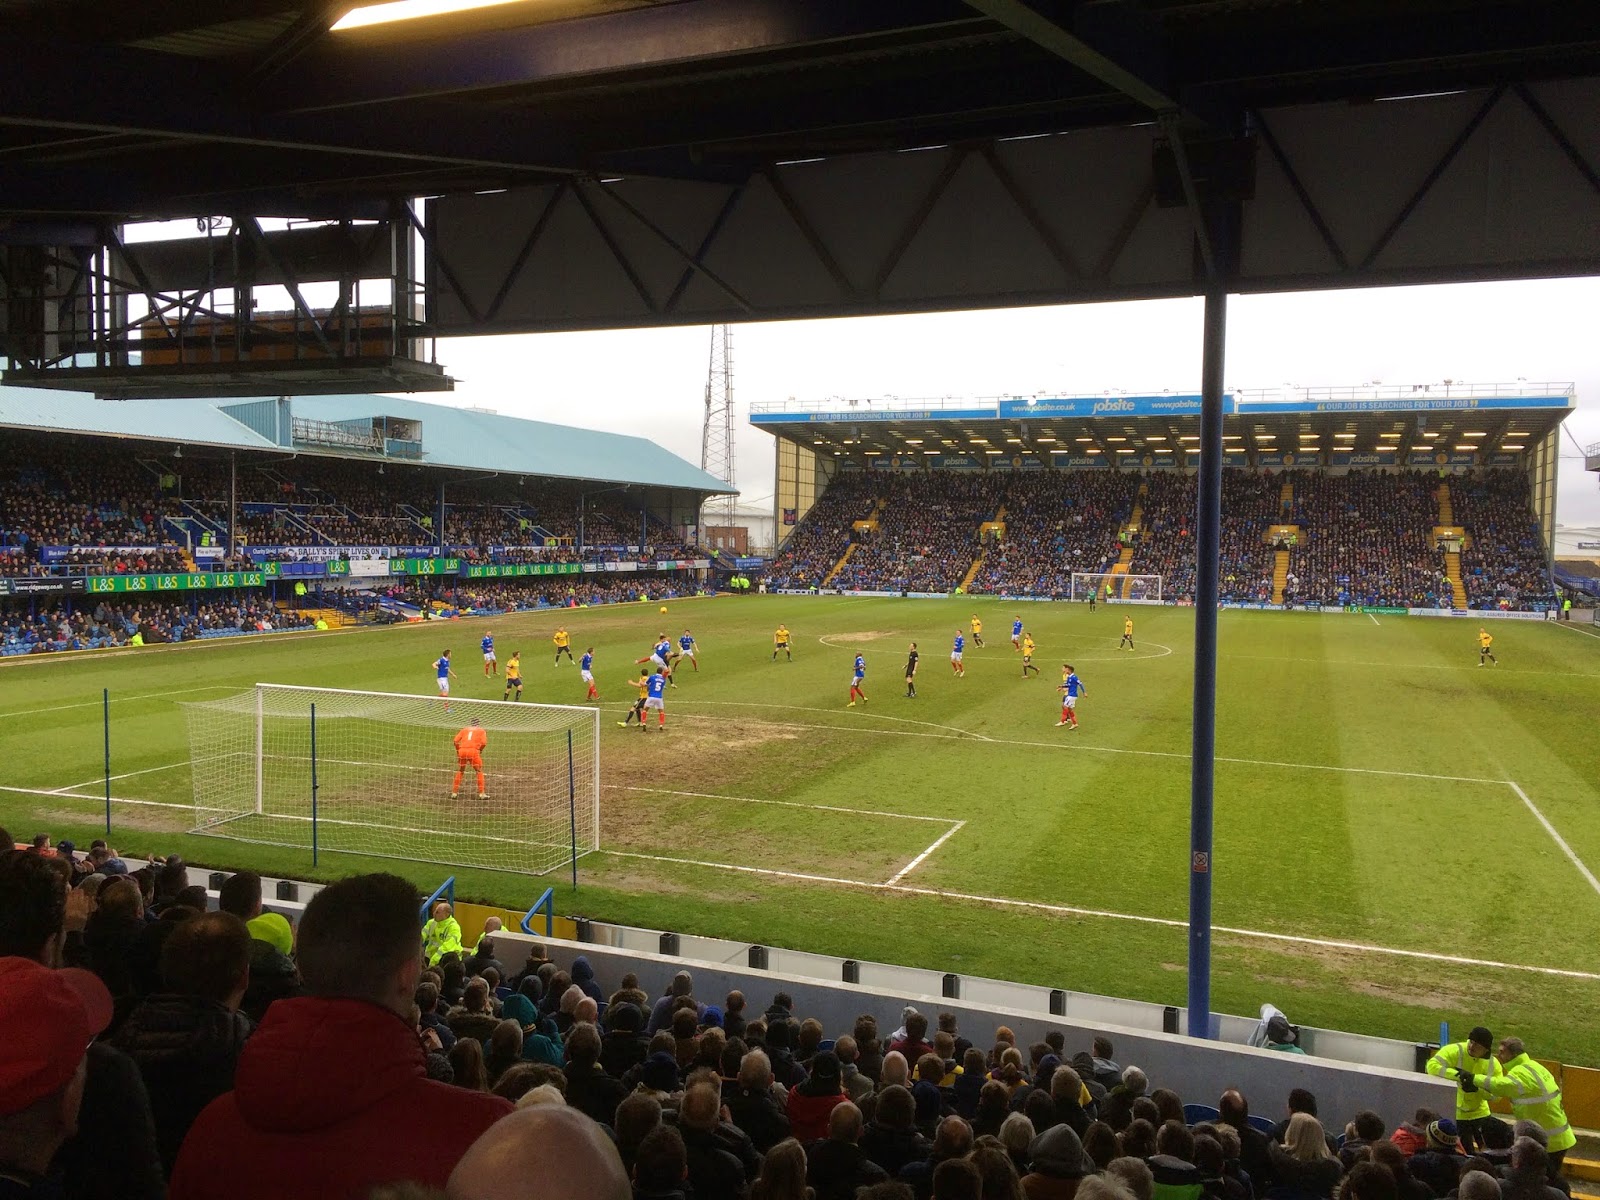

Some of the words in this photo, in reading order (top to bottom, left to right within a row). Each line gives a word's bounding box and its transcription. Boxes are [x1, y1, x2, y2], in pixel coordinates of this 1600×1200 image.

[1092, 399, 1135, 415] jobsite
[1152, 400, 1202, 411] www.jobsite.
[1359, 402, 1367, 410] IS
[1368, 401, 1413, 410] SEARCHING
[1414, 401, 1430, 409] FOR
[1431, 400, 1452, 408] YOUR
[848, 412, 882, 420] SEARCHING
[895, 411, 911, 419] YOUR
[943, 457, 968, 466] jobsite
[1068, 457, 1095, 467] jobsite
[1349, 454, 1380, 465] jobsite
[298, 548, 327, 556] BALLY'S
[330, 561, 345, 573] L&S
[392, 560, 404, 572] L&S
[417, 560, 434, 574] L&S
[446, 560, 457, 570] L&S
[544, 565, 554, 574] L&S
[570, 565, 579, 573] L&S
[471, 567, 482, 577] L&S
[486, 566, 497, 576] L&S
[503, 566, 512, 576] L&S
[517, 566, 527, 575] L&S
[531, 566, 541, 575] L&S
[93, 578, 114, 592] L&S
[126, 577, 146, 591] L&S
[158, 576, 178, 590] L&S
[187, 575, 206, 589] L&S
[216, 574, 234, 587] L&S
[243, 574, 261, 586] L&S
[655, 682, 662, 691] 5
[468, 731, 473, 741] 1
